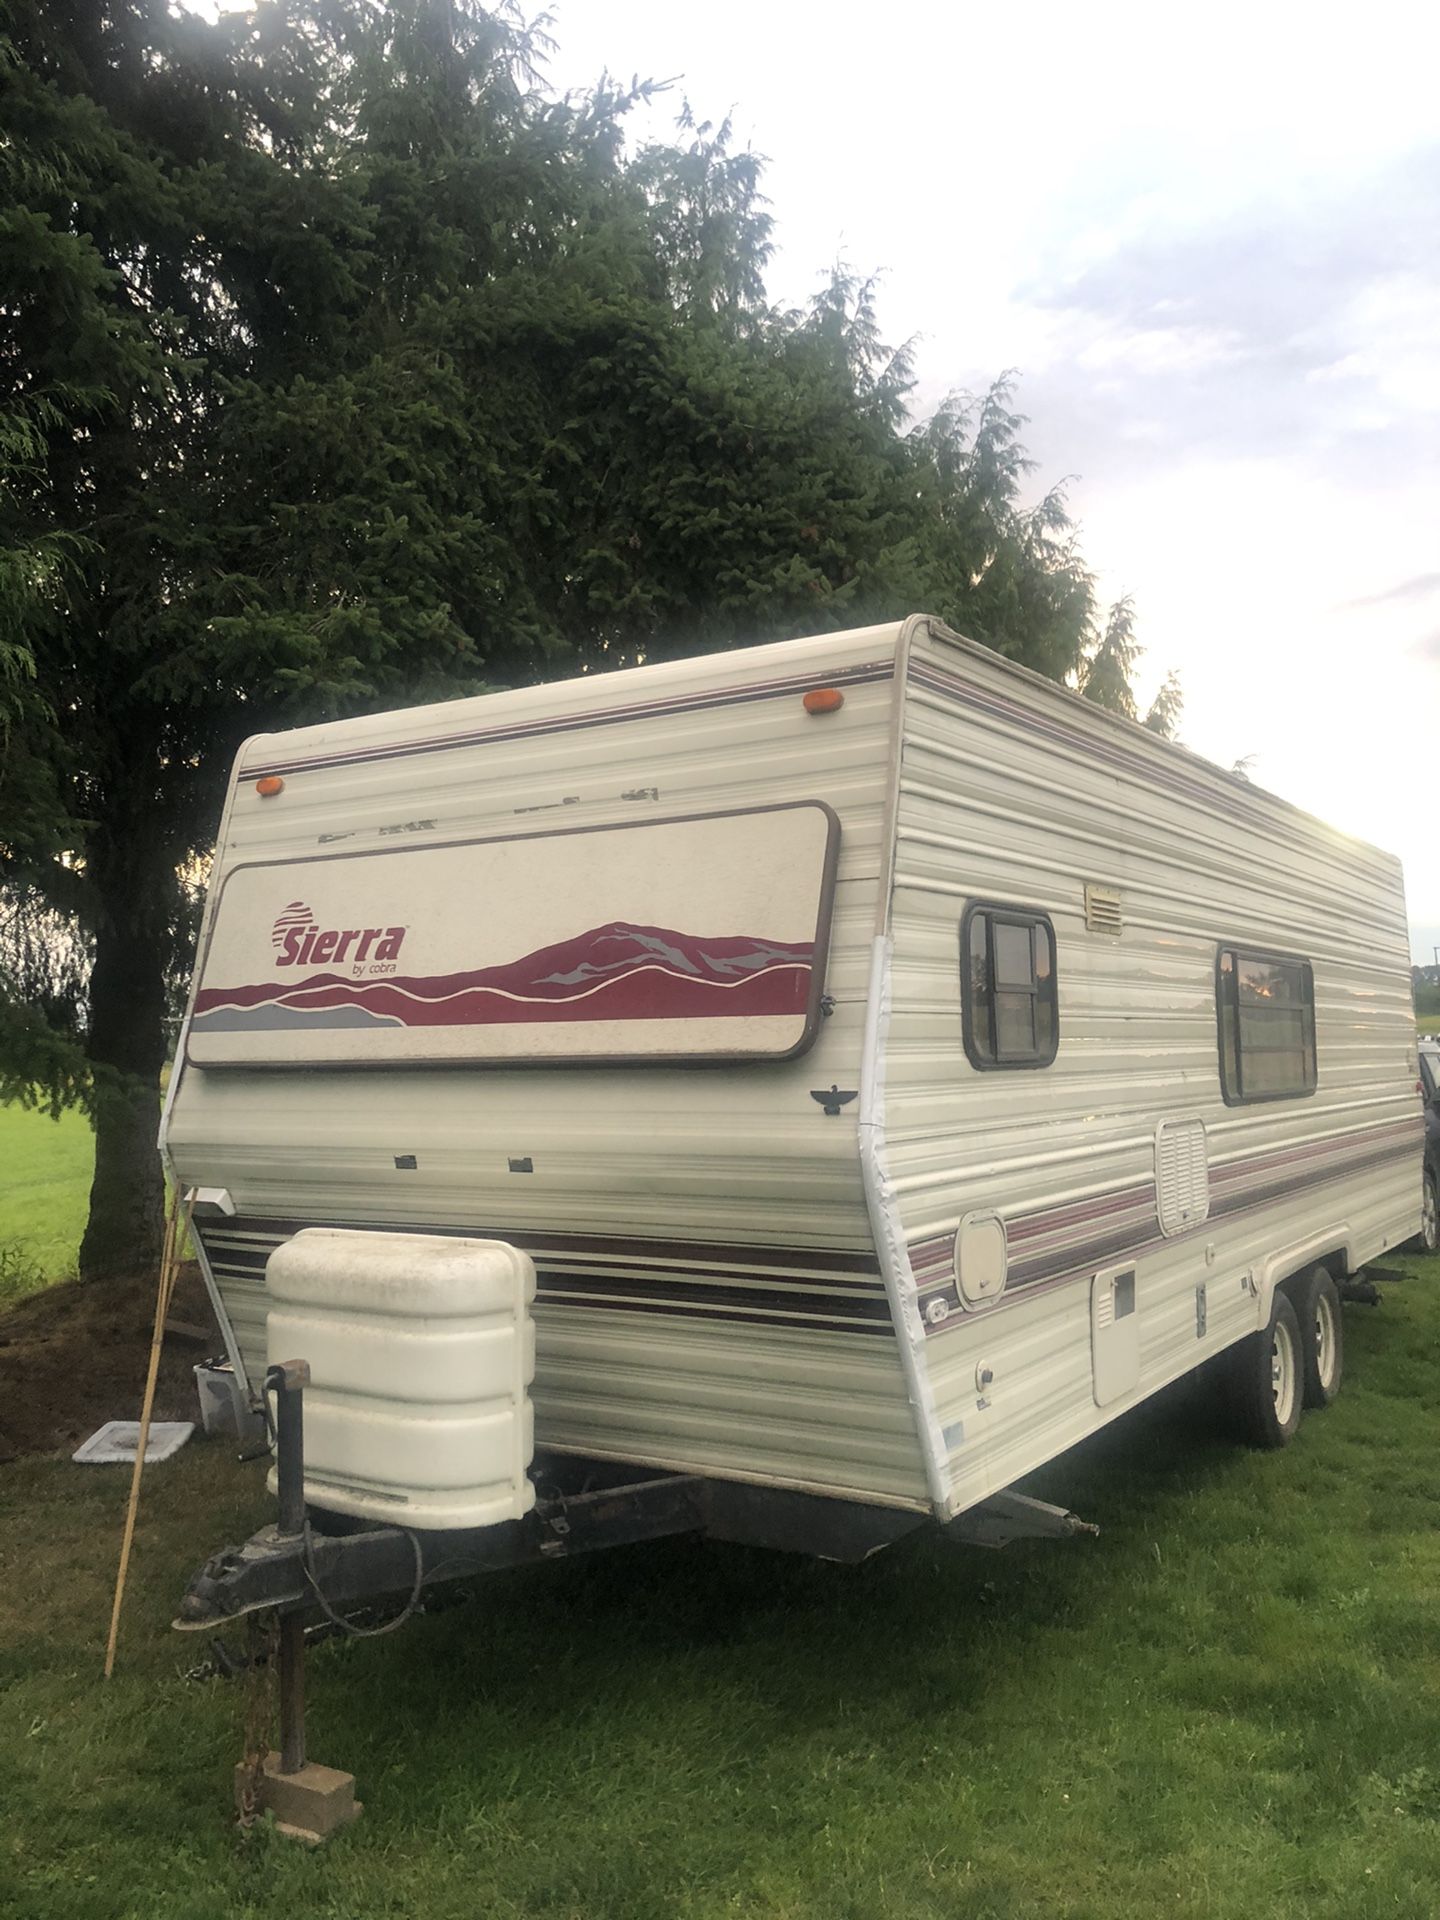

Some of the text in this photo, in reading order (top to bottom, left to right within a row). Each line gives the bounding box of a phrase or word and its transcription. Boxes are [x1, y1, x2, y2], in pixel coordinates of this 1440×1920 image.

[276, 926, 406, 966] Sierra
[352, 963, 397, 977] by cobra
